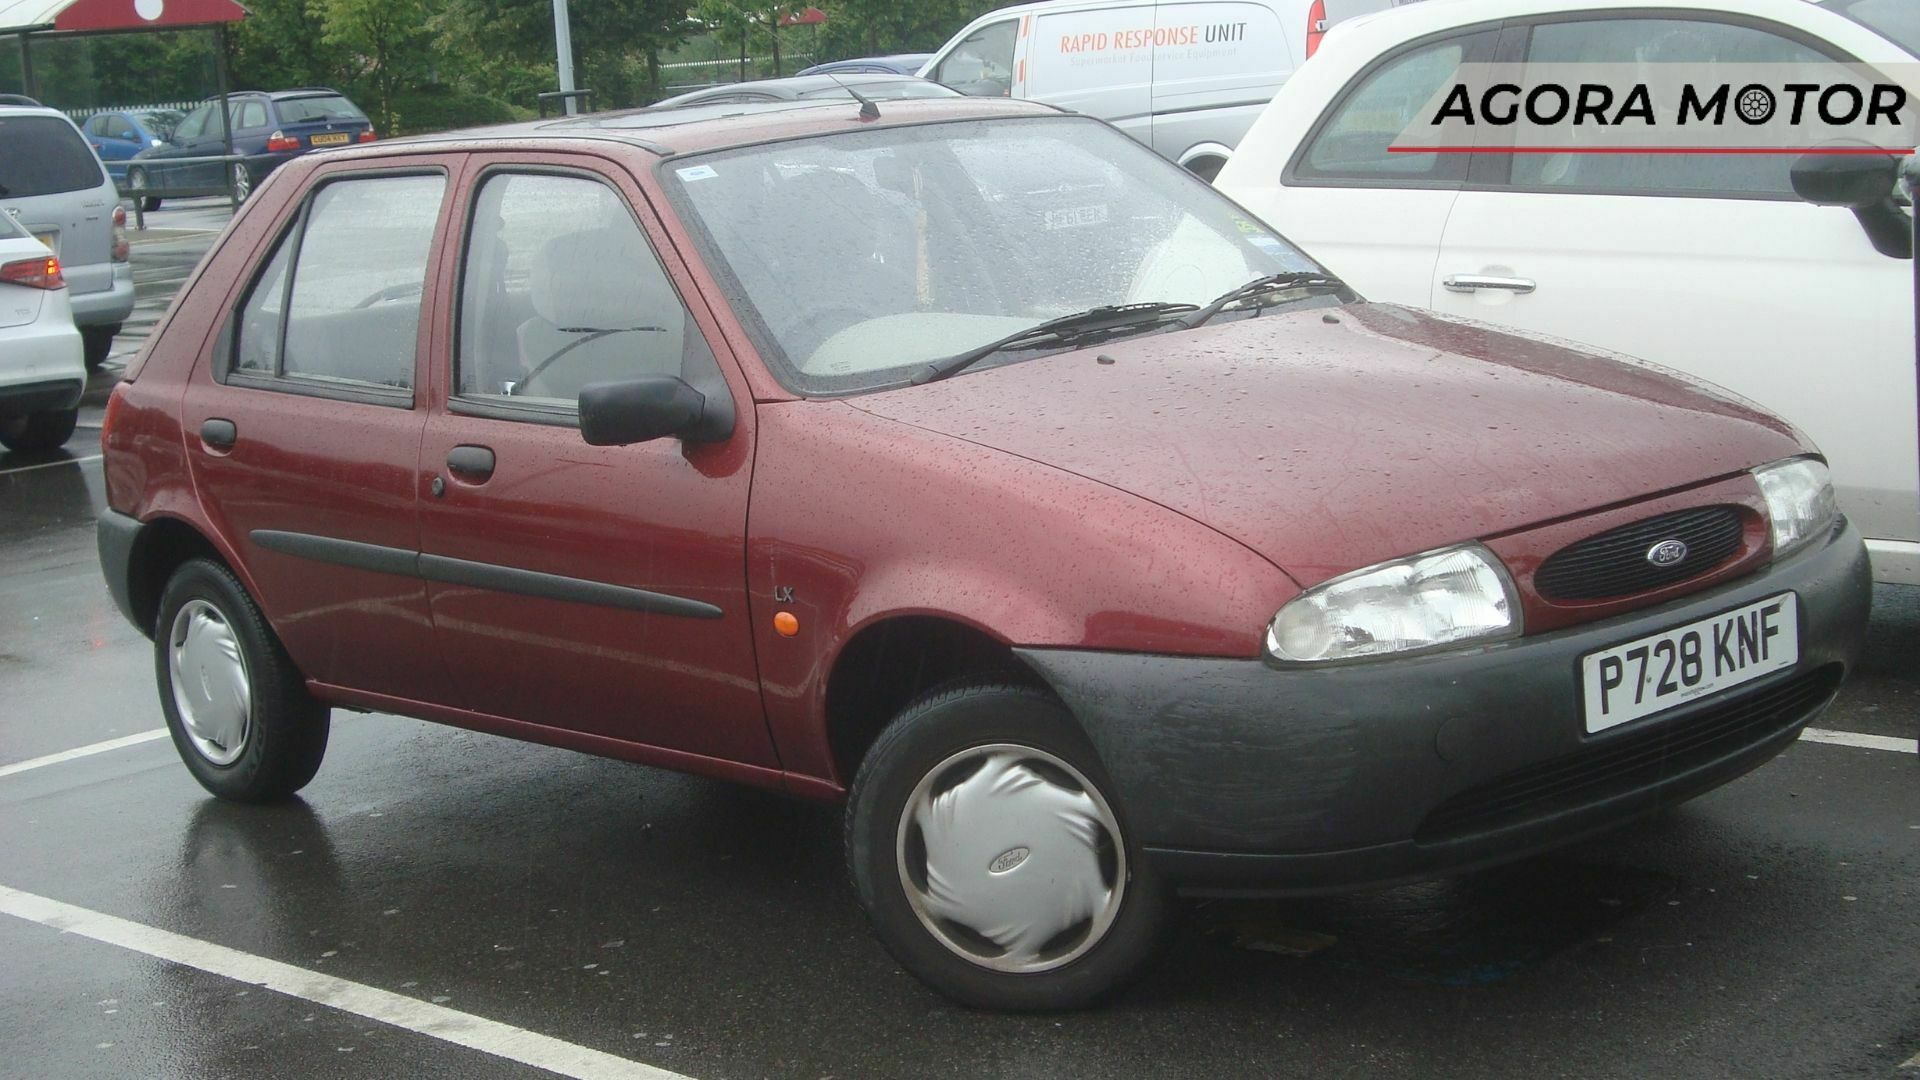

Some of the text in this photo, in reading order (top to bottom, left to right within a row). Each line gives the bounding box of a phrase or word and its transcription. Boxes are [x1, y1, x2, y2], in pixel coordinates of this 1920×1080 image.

[1061, 22, 1247, 53] RAPID RESPONSE UNIT
[1187, 47, 1237, 60] Equipment
[774, 585, 793, 603] LX
[1599, 603, 1781, 715] P728 KNF
[998, 850, 1023, 870] Ford
